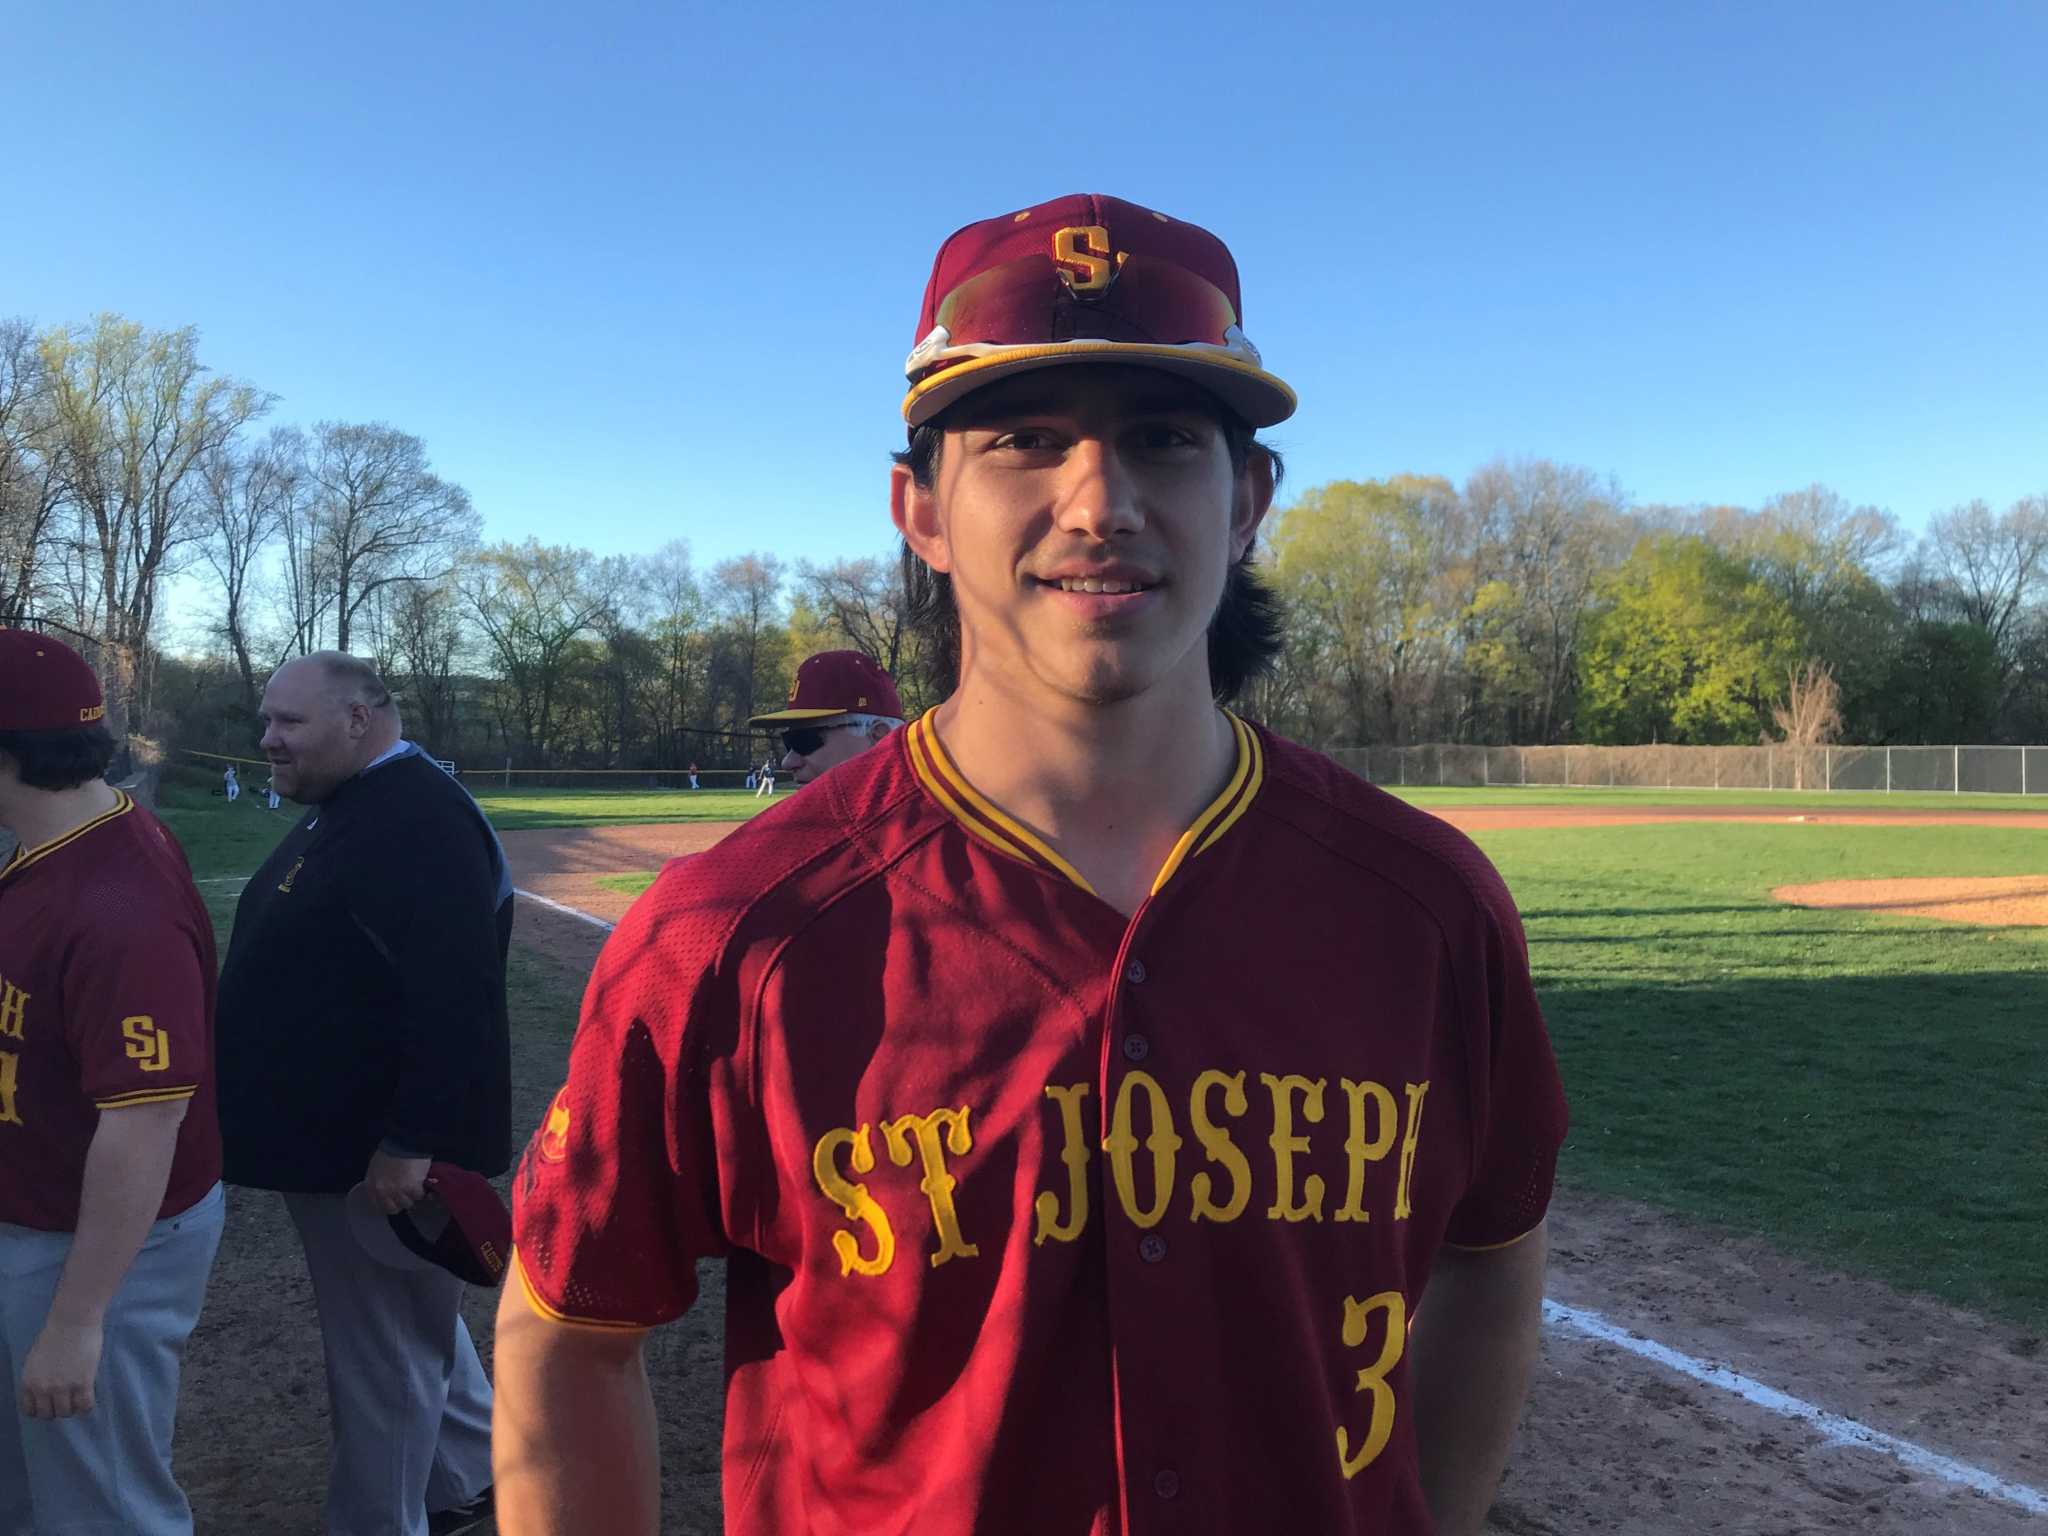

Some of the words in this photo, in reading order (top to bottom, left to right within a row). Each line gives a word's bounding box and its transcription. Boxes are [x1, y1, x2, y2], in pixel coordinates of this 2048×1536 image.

[1055, 226, 1129, 291] S
[121, 1015, 170, 1072] SJ
[813, 1105, 979, 1278] ST
[1336, 1291, 1406, 1481] 3
